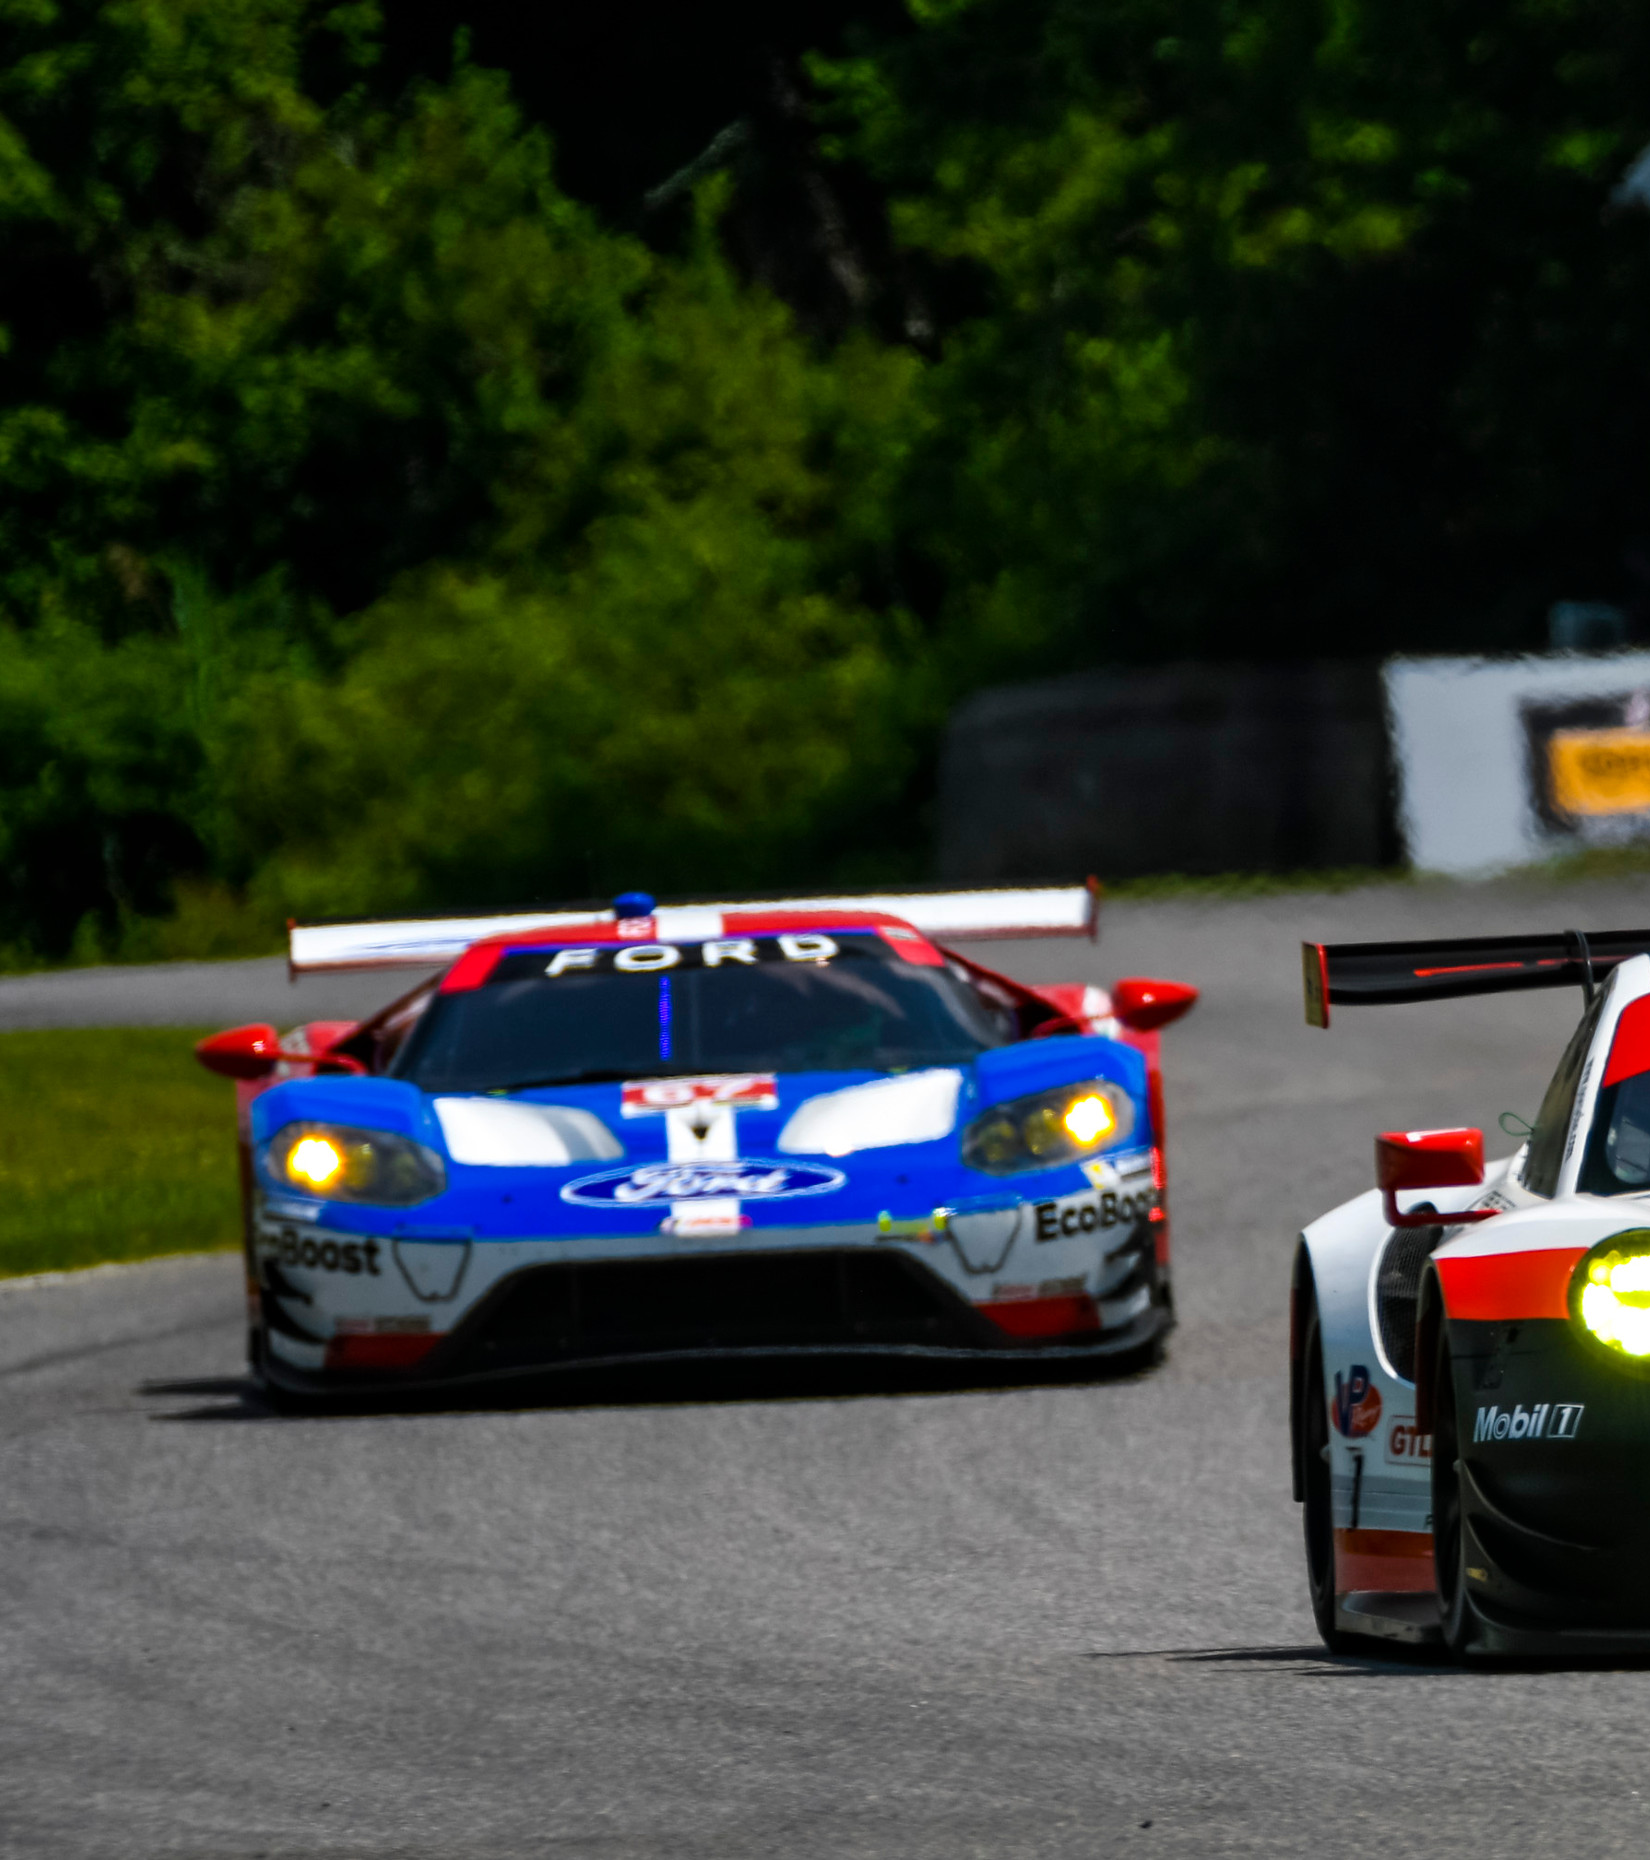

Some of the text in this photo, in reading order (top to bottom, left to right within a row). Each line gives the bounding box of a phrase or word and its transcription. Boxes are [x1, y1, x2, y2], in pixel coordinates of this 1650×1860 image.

[545, 934, 839, 977] FORD
[613, 1162, 789, 1202] Ford
[1473, 1404, 1549, 1443] Mobil
